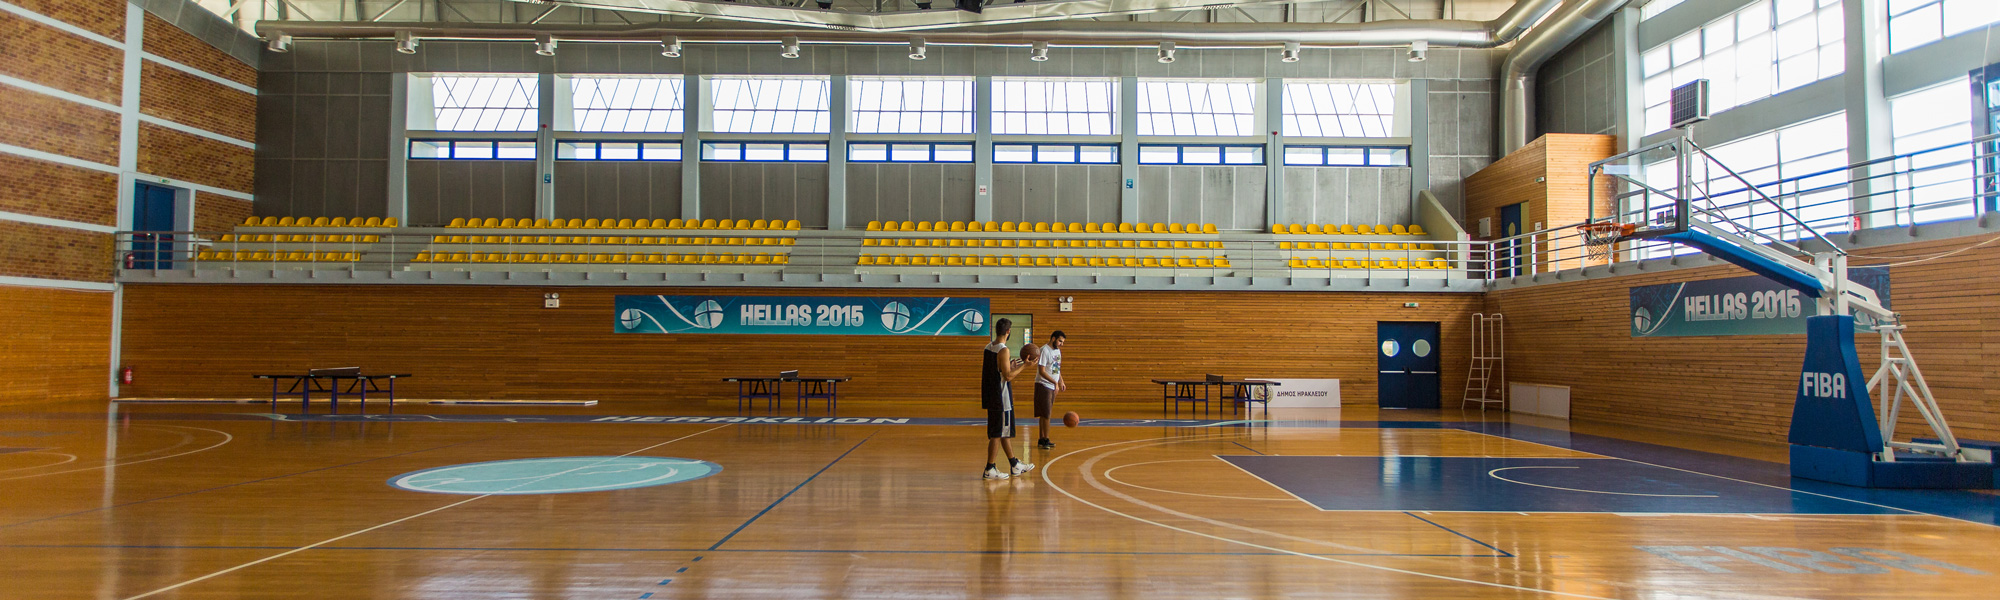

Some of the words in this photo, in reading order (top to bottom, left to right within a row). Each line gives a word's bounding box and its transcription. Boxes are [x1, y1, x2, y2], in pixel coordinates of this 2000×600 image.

[740, 304, 812, 326] HELLAS
[816, 304, 865, 327] 2015
[1684, 292, 1748, 321] HELLAS
[1751, 289, 1801, 319] 2015
[1802, 371, 1846, 399] FIBA
[590, 416, 910, 424] HERAKLION
[1632, 545, 1993, 575] FIBA
